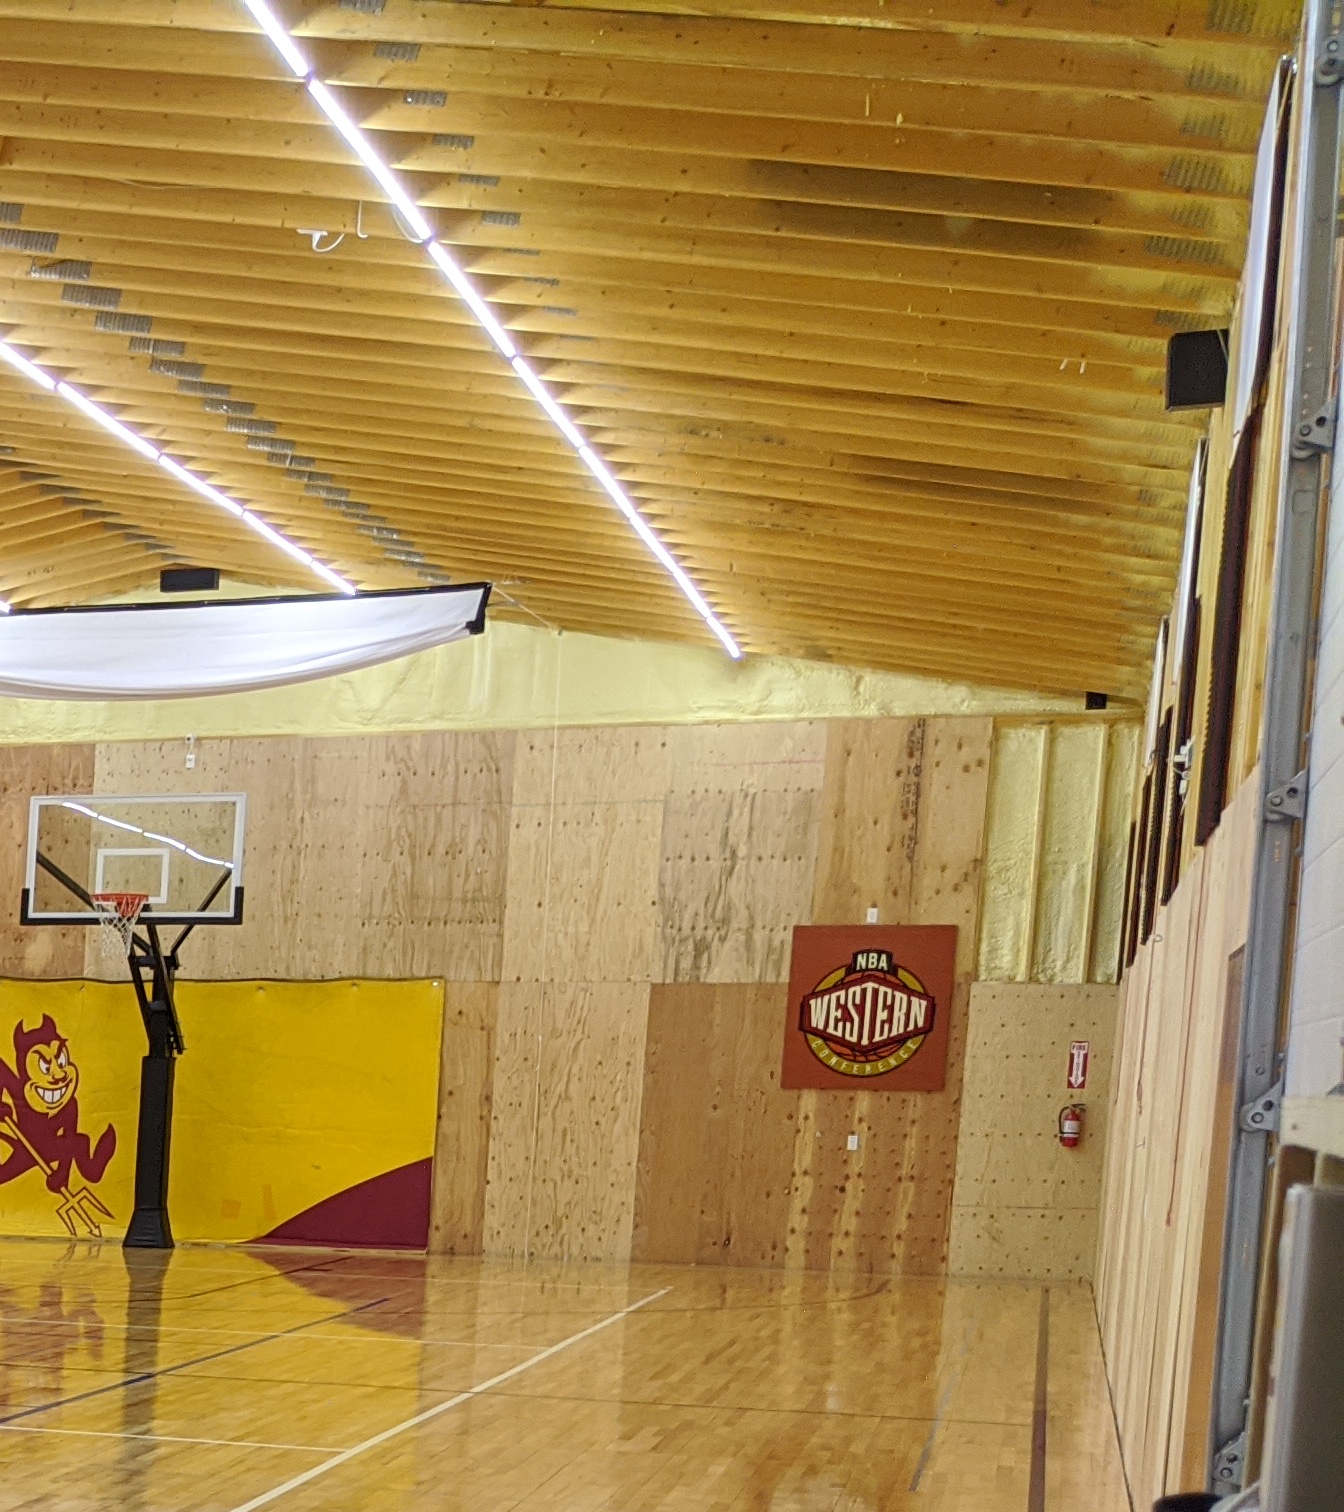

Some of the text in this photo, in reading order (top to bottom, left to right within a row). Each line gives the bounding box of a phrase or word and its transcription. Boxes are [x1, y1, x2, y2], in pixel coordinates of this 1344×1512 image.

[855, 952, 888, 971] NBA
[809, 981, 928, 1046] WESTERN
[812, 1040, 918, 1075] CONFERENCE
